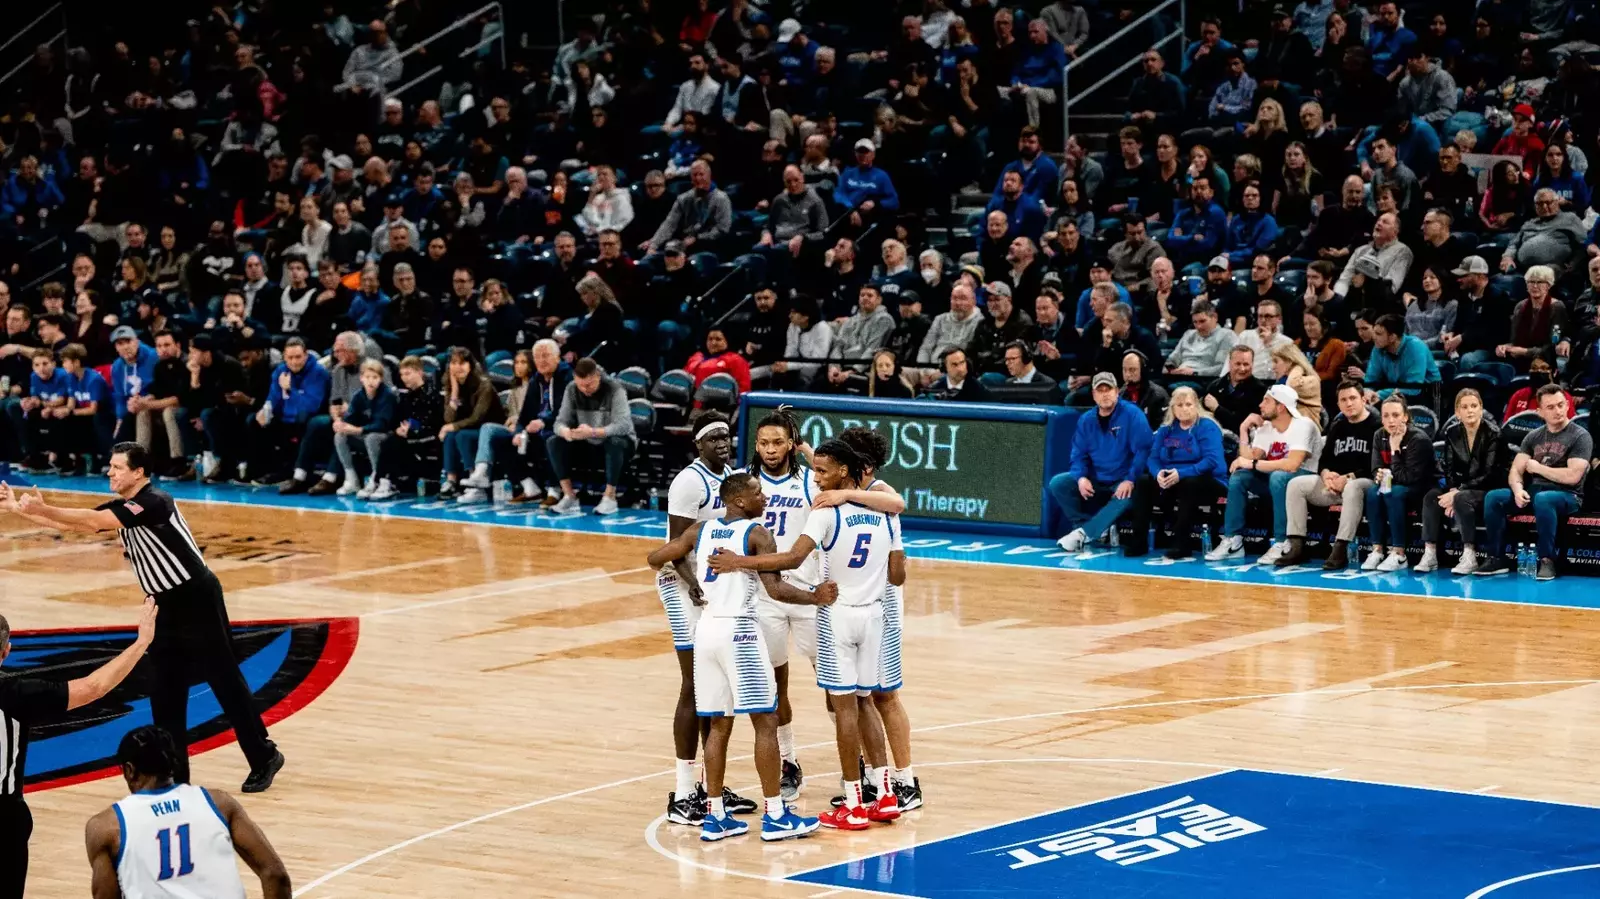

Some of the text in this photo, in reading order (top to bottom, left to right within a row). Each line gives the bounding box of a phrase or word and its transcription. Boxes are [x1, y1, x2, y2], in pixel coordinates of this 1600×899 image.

[841, 419, 960, 470] USH
[764, 494, 803, 508] EPAUL
[914, 488, 989, 518] Therapy
[764, 511, 787, 536] 21
[847, 533, 872, 568] 5
[151, 799, 181, 817] PENN
[155, 823, 195, 881] 11
[1006, 803, 1230, 870] EAST
[1095, 815, 1268, 866] BIG
